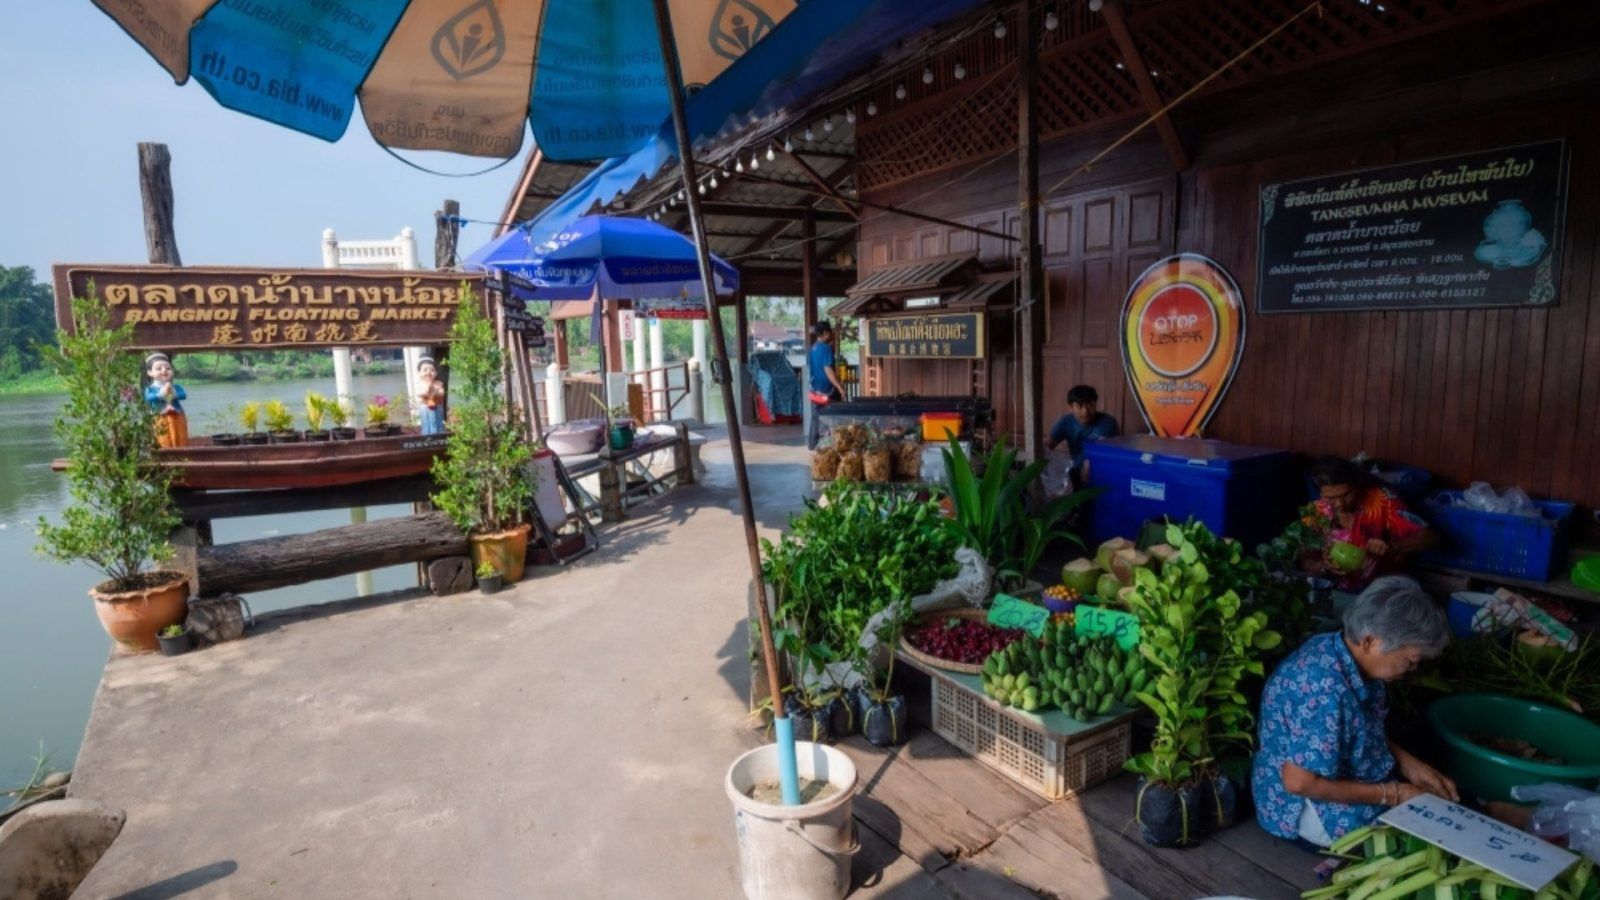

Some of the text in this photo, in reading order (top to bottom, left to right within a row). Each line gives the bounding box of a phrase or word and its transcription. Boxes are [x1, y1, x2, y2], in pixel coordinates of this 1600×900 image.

[1304, 218, 1422, 244] ตลาดน้ำบางน้อย
[105, 275, 463, 306] ตลาดน้ำบางน้อย
[124, 307, 452, 323] BANGNOI FLOATING MARKET
[1154, 314, 1198, 330] OTOP
